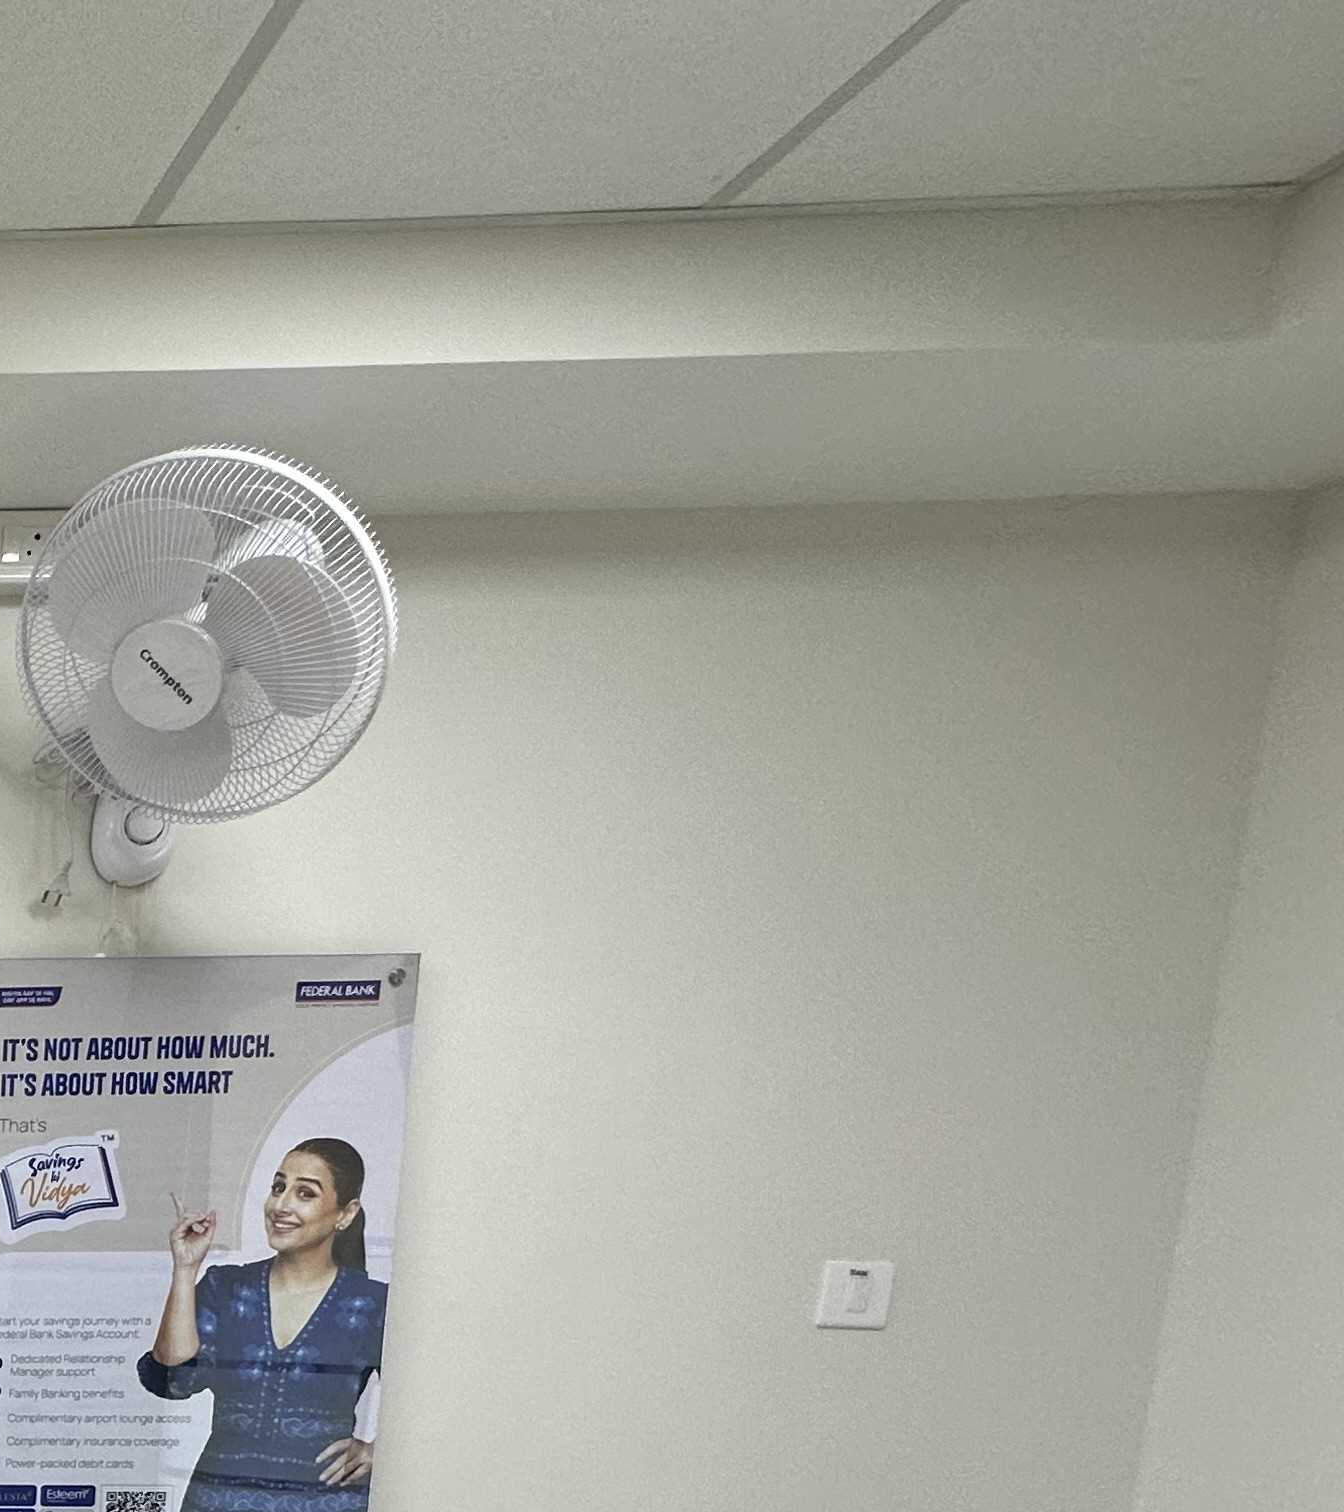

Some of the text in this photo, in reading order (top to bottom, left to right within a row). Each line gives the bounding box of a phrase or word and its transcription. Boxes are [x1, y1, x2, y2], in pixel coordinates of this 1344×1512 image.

[140, 649, 192, 704] Crompton
[301, 984, 376, 996] FEDERAL BANK
[2, 1035, 275, 1062] IT'S NOT ABOUT HOW MUCH.
[1, 1070, 232, 1096] IT'S ABOUT HOW SMART
[0, 1117, 47, 1133] That's
[28, 1153, 84, 1176] Savings
[20, 1172, 90, 1209] Vidya
[20, 1318, 40, 1327] your
[44, 1317, 79, 1328] savings
[82, 1317, 119, 1328] journey
[121, 1317, 143, 1326] with
[30, 1329, 54, 1339] Bank
[56, 1329, 94, 1341] Savings
[10, 1354, 125, 1365] Dedicated Relationship
[10, 1367, 95, 1379] Manager support
[9, 1389, 125, 1401] Family Banking benefits
[7, 1412, 192, 1426] Complimentary airport lounge access
[6, 1436, 179, 1448] Complimentary insurance coverage
[5, 1458, 134, 1469] Power-packed debit cards
